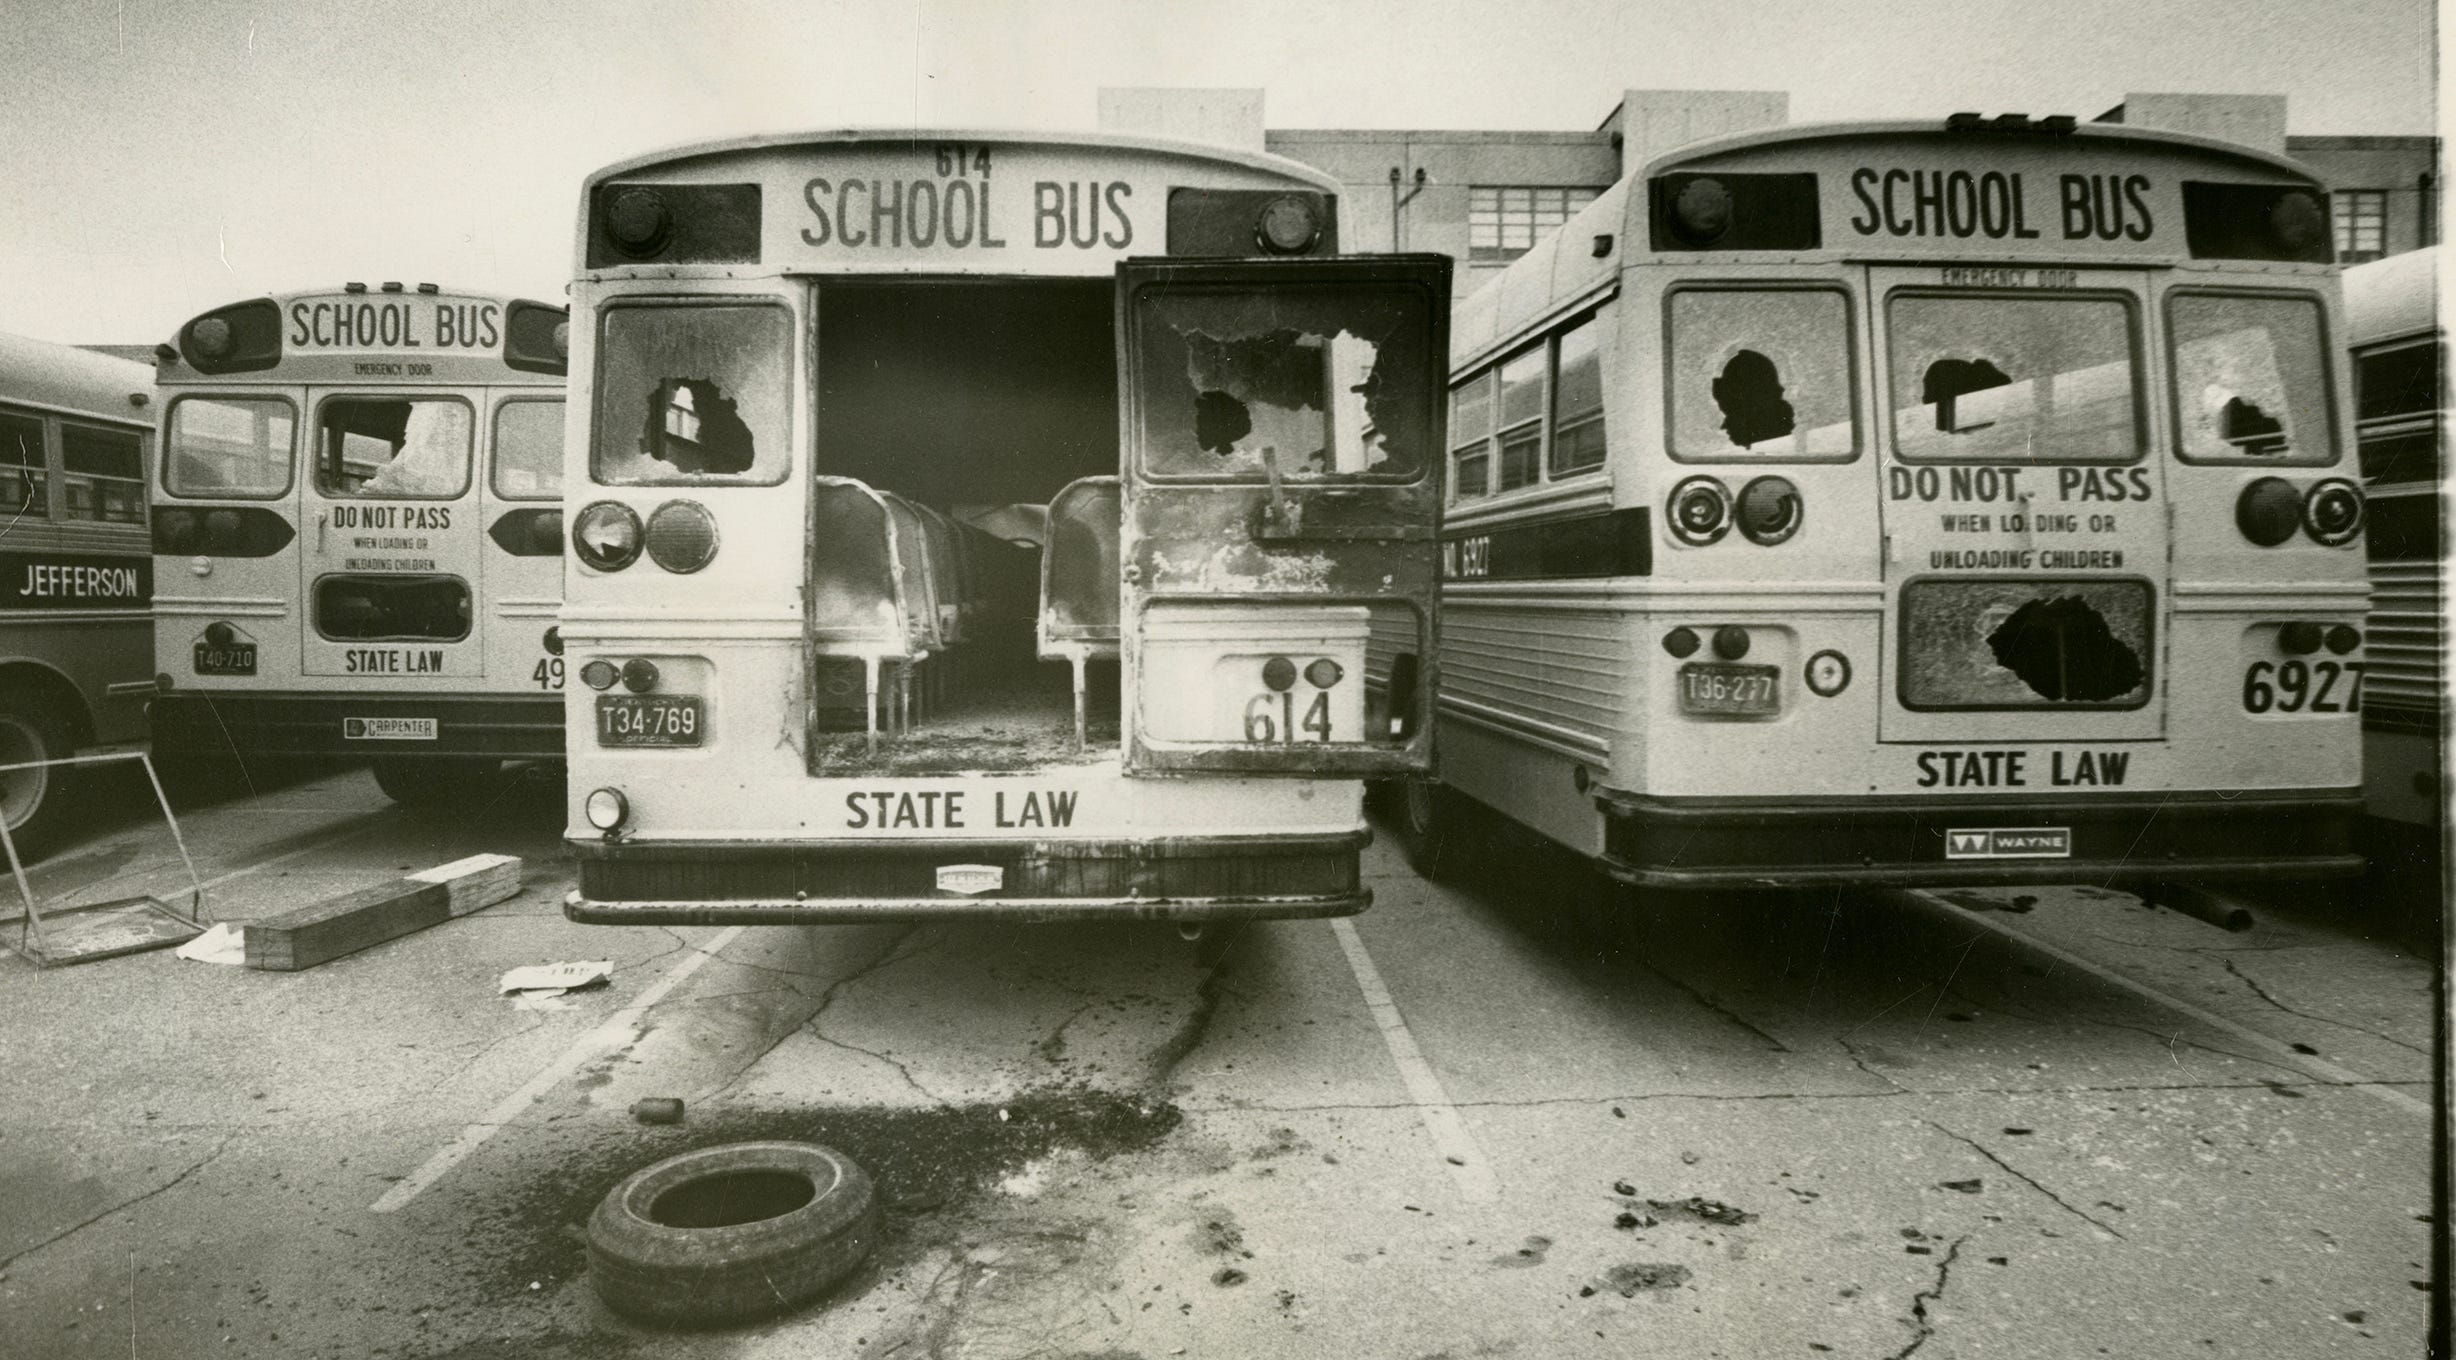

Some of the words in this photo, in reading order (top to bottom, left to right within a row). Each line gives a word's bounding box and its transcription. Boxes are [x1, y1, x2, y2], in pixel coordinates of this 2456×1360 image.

[935, 143, 992, 178] 614
[801, 178, 1006, 247] SCHOOL
[1034, 181, 1133, 249] BUS
[1851, 167, 2040, 239] SCHOOL
[2060, 173, 2154, 242] BUS
[292, 303, 420, 347] SCHOOL
[436, 304, 498, 348] BUS
[355, 363, 401, 375] EMERGENCY
[408, 364, 432, 375] DOOR
[1889, 466, 1940, 501] DO
[1950, 467, 2021, 502] NOT
[2058, 467, 2151, 502] PASS
[334, 506, 357, 528] DO
[362, 506, 397, 528] NOT
[404, 507, 450, 529] PASS
[1941, 514, 1991, 532] WHEN
[2000, 514, 2077, 532] LODING
[2088, 514, 2116, 532] OR
[353, 537, 377, 549] WHEN
[379, 537, 414, 549] LOADING
[416, 538, 428, 549] OR
[1463, 536, 1490, 576] 6927
[345, 558, 392, 570] UNLOADING
[395, 559, 435, 570] CHILDREN
[1930, 550, 2032, 569] UNLOADING
[2039, 550, 2123, 568] CHILDREN
[20, 565, 137, 597] JEFFERSON
[346, 650, 399, 672] STATE
[406, 651, 443, 672] LAW
[533, 658, 565, 690] 49
[2243, 660, 2366, 714] 6927
[368, 720, 432, 737] CARPENTER
[1244, 691, 1333, 742] 614
[1917, 751, 2026, 787] STATE
[2051, 751, 2130, 786] LAW
[846, 791, 965, 829] STATE
[995, 790, 1078, 828] LAW
[1997, 837, 2064, 848] WAYNE
